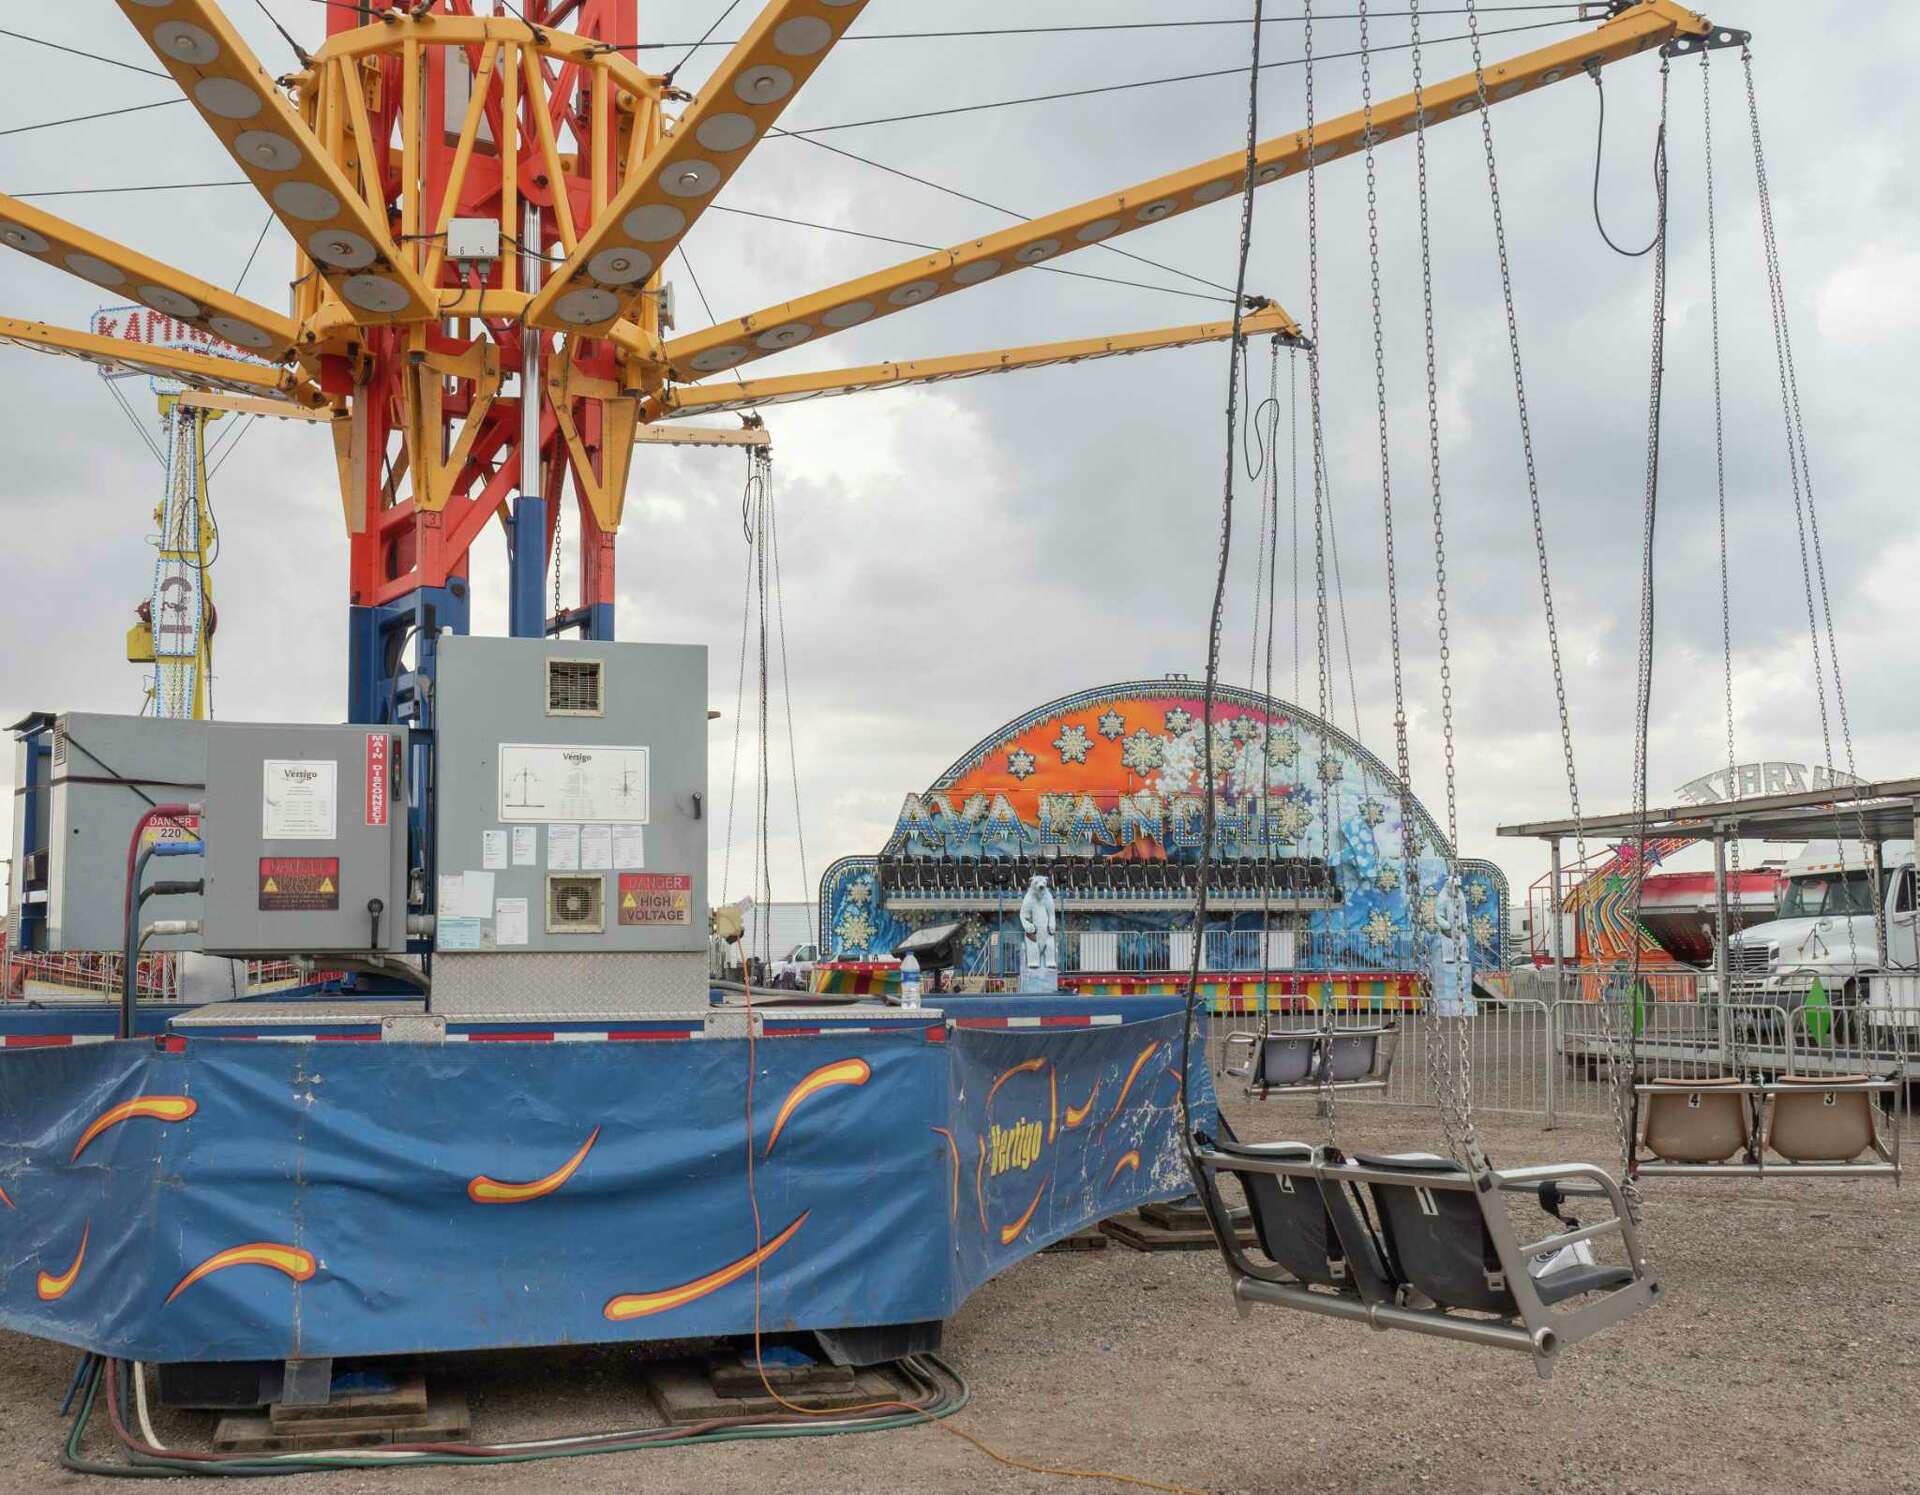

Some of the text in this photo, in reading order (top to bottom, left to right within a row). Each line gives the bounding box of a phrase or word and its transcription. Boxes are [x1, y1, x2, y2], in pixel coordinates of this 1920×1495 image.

[371, 735, 384, 760] MAIN
[563, 752, 593, 763] Vertigo
[284, 768, 318, 781] Vertigo
[894, 792, 1294, 847] AVALANCHE
[160, 828, 181, 838] 220
[640, 896, 671, 907] HIGH
[627, 910, 685, 921] VOLTAGE
[991, 1116, 1042, 1176] Vertigo
